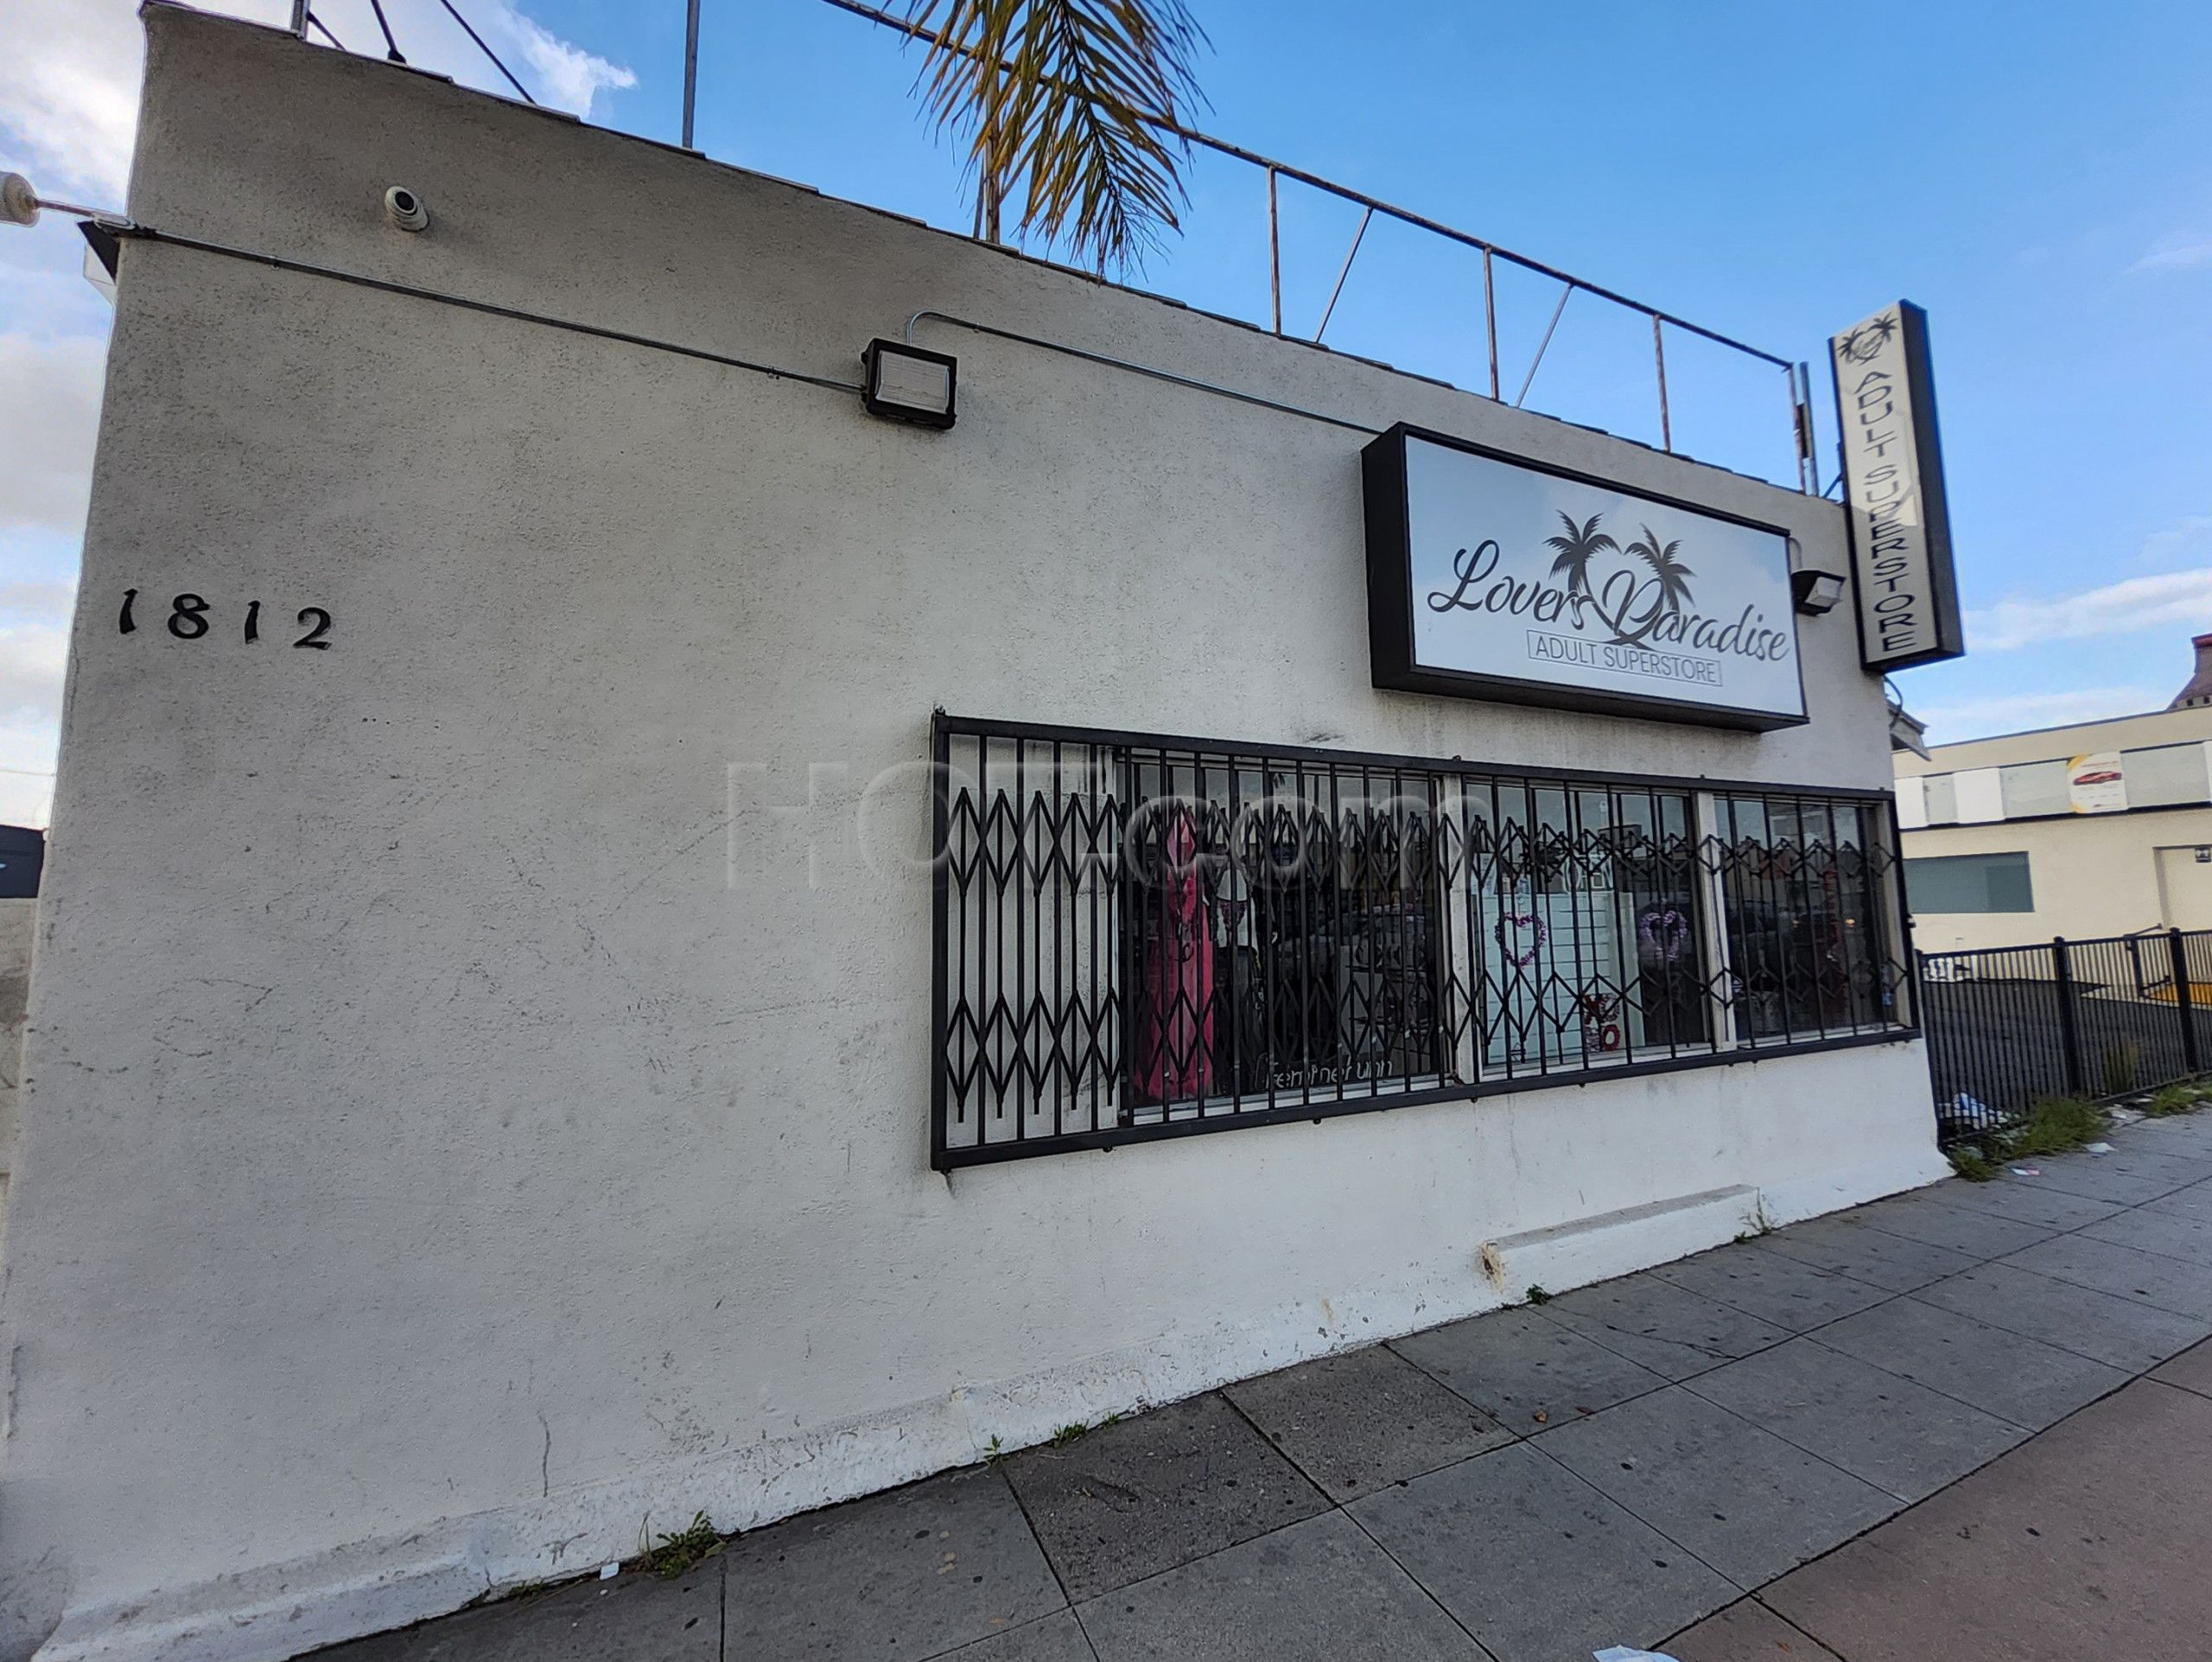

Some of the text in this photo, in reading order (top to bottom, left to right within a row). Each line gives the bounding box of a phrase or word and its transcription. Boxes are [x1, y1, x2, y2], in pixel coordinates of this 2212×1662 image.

[1854, 371, 1918, 653] ADULT SUPERSTORE
[119, 588, 332, 650] 1812
[1602, 569, 1790, 662] Paradise
[1535, 637, 1717, 683] ADULT SUPERSTORE
